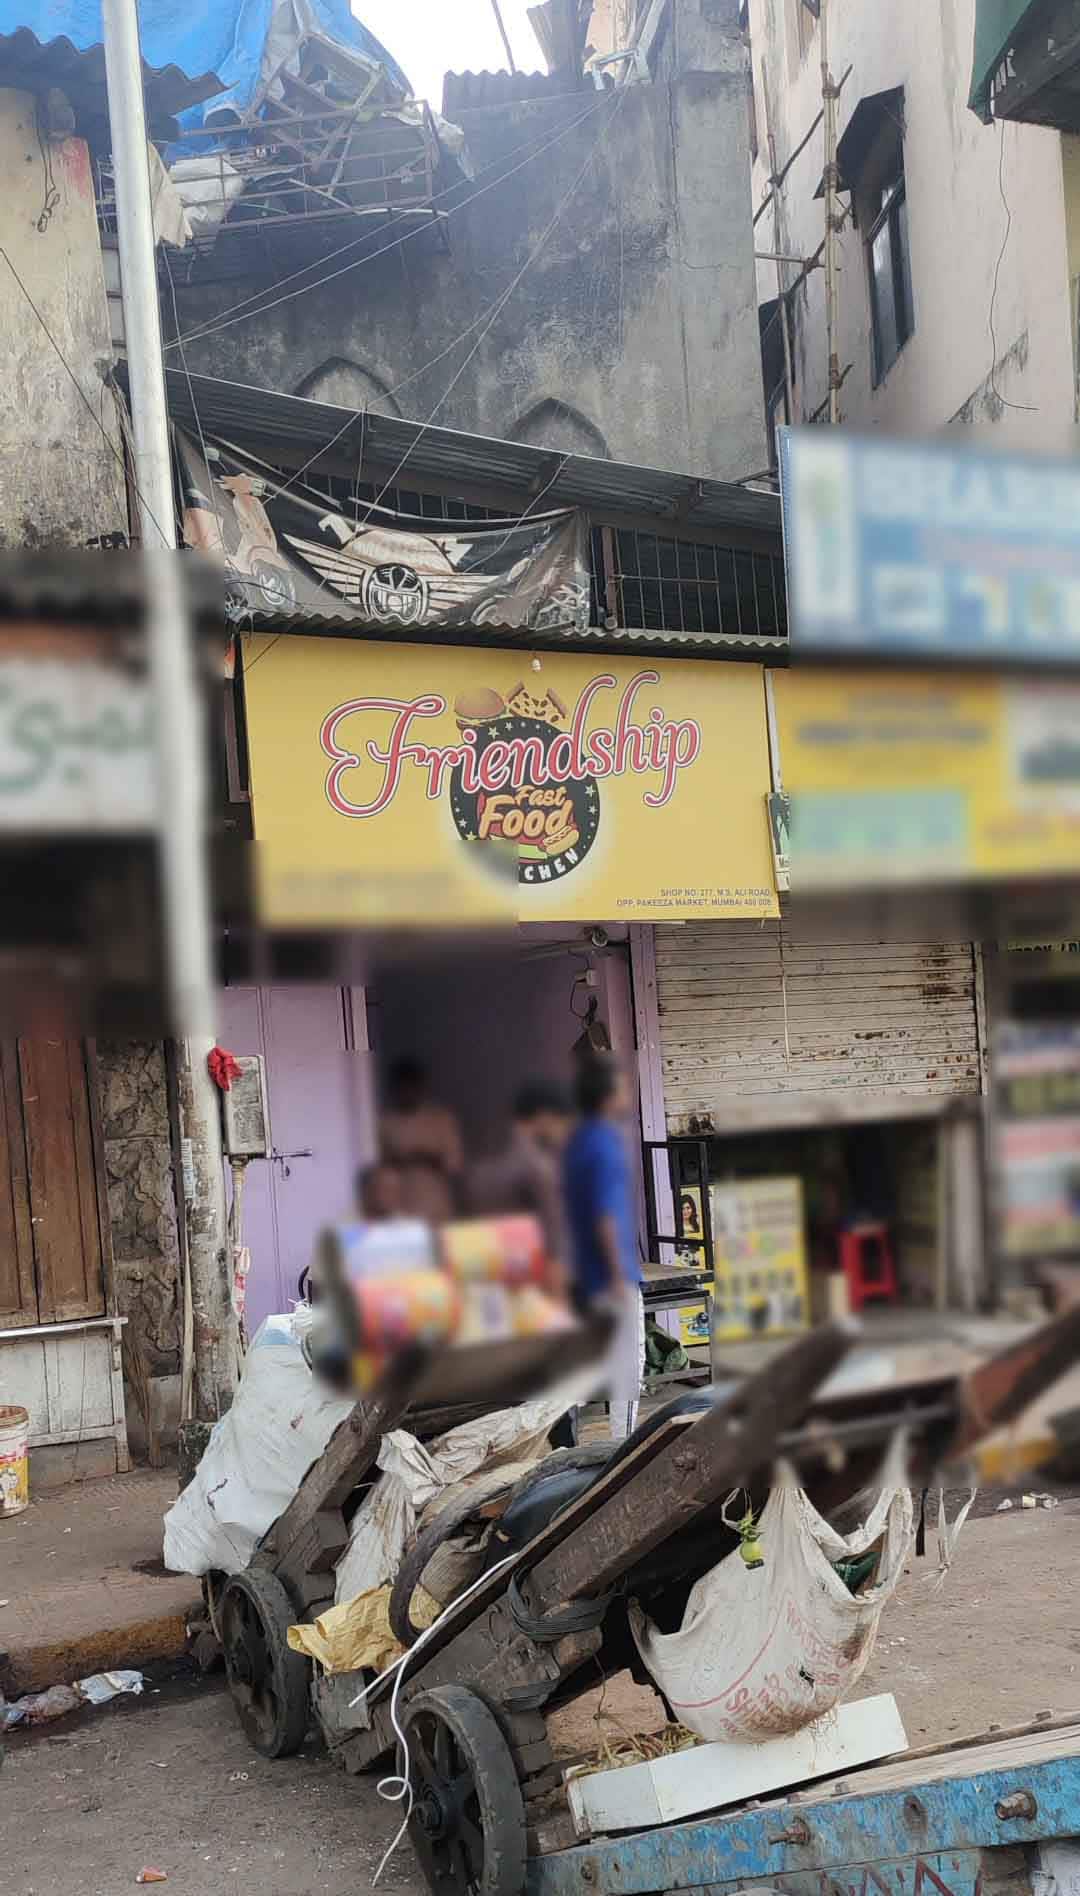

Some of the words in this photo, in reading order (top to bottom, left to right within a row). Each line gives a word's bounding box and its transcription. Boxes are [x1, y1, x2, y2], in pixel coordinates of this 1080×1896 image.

[319, 670, 702, 819] Friendship
[514, 785, 568, 807] Fast
[478, 794, 574, 840] Food
[519, 847, 579, 881] CHEN
[660, 888, 683, 897] SHOP
